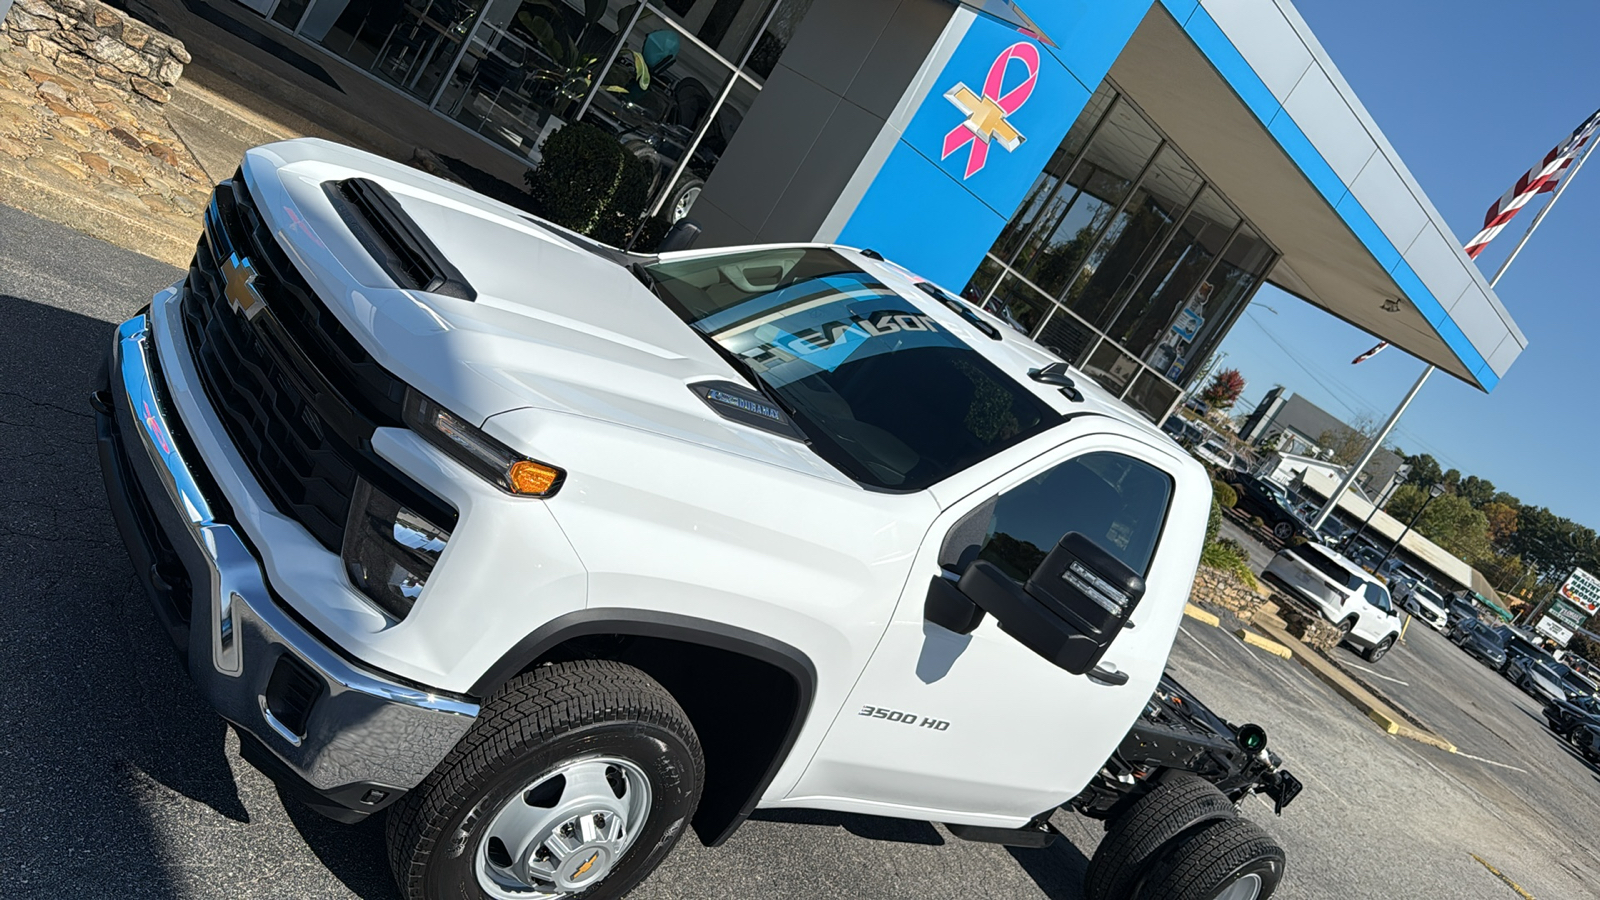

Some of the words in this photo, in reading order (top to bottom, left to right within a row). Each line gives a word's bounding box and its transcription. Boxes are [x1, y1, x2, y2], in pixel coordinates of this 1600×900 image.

[739, 397, 780, 420] DURAMAX
[1571, 573, 1600, 593] HEALTHY
[1571, 580, 1600, 600] HARVEST
[1569, 586, 1600, 608] PRODUCE
[858, 705, 918, 724] 3500
[919, 717, 950, 731] HD
